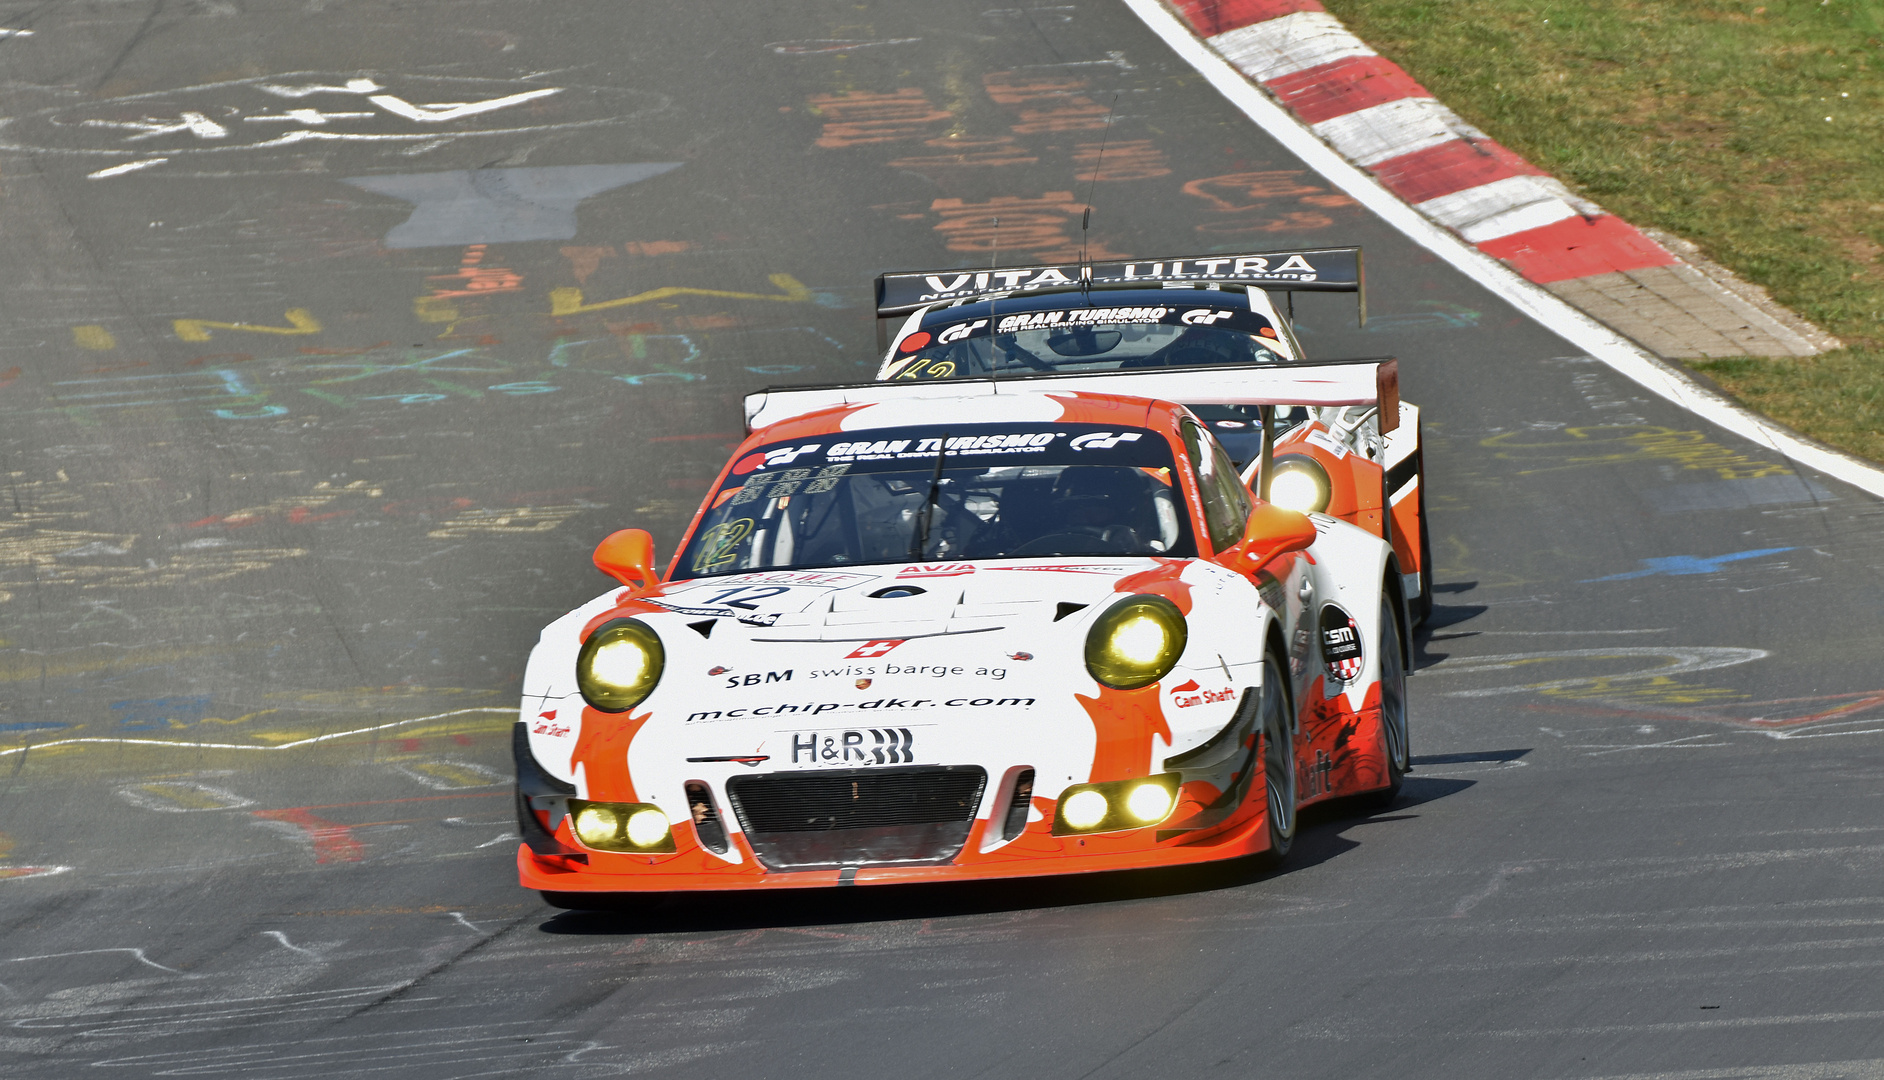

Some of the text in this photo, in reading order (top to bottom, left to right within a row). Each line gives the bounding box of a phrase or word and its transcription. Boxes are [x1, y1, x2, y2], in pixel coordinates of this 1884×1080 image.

[1124, 254, 1317, 279] ULTRA
[998, 307, 1167, 328] GRAN TURISMO
[827, 433, 1055, 456] GRAN TURISMO
[897, 450, 957, 459] DRIVIG
[960, 446, 1045, 456] SIMULATOR
[692, 518, 755, 572] 12
[701, 585, 791, 610] 12
[725, 663, 1007, 689] SBM swiss barge ag
[686, 697, 1036, 722] mcchip-dkr.com
[1174, 695, 1202, 709] Cam
[791, 731, 866, 763] H&R
